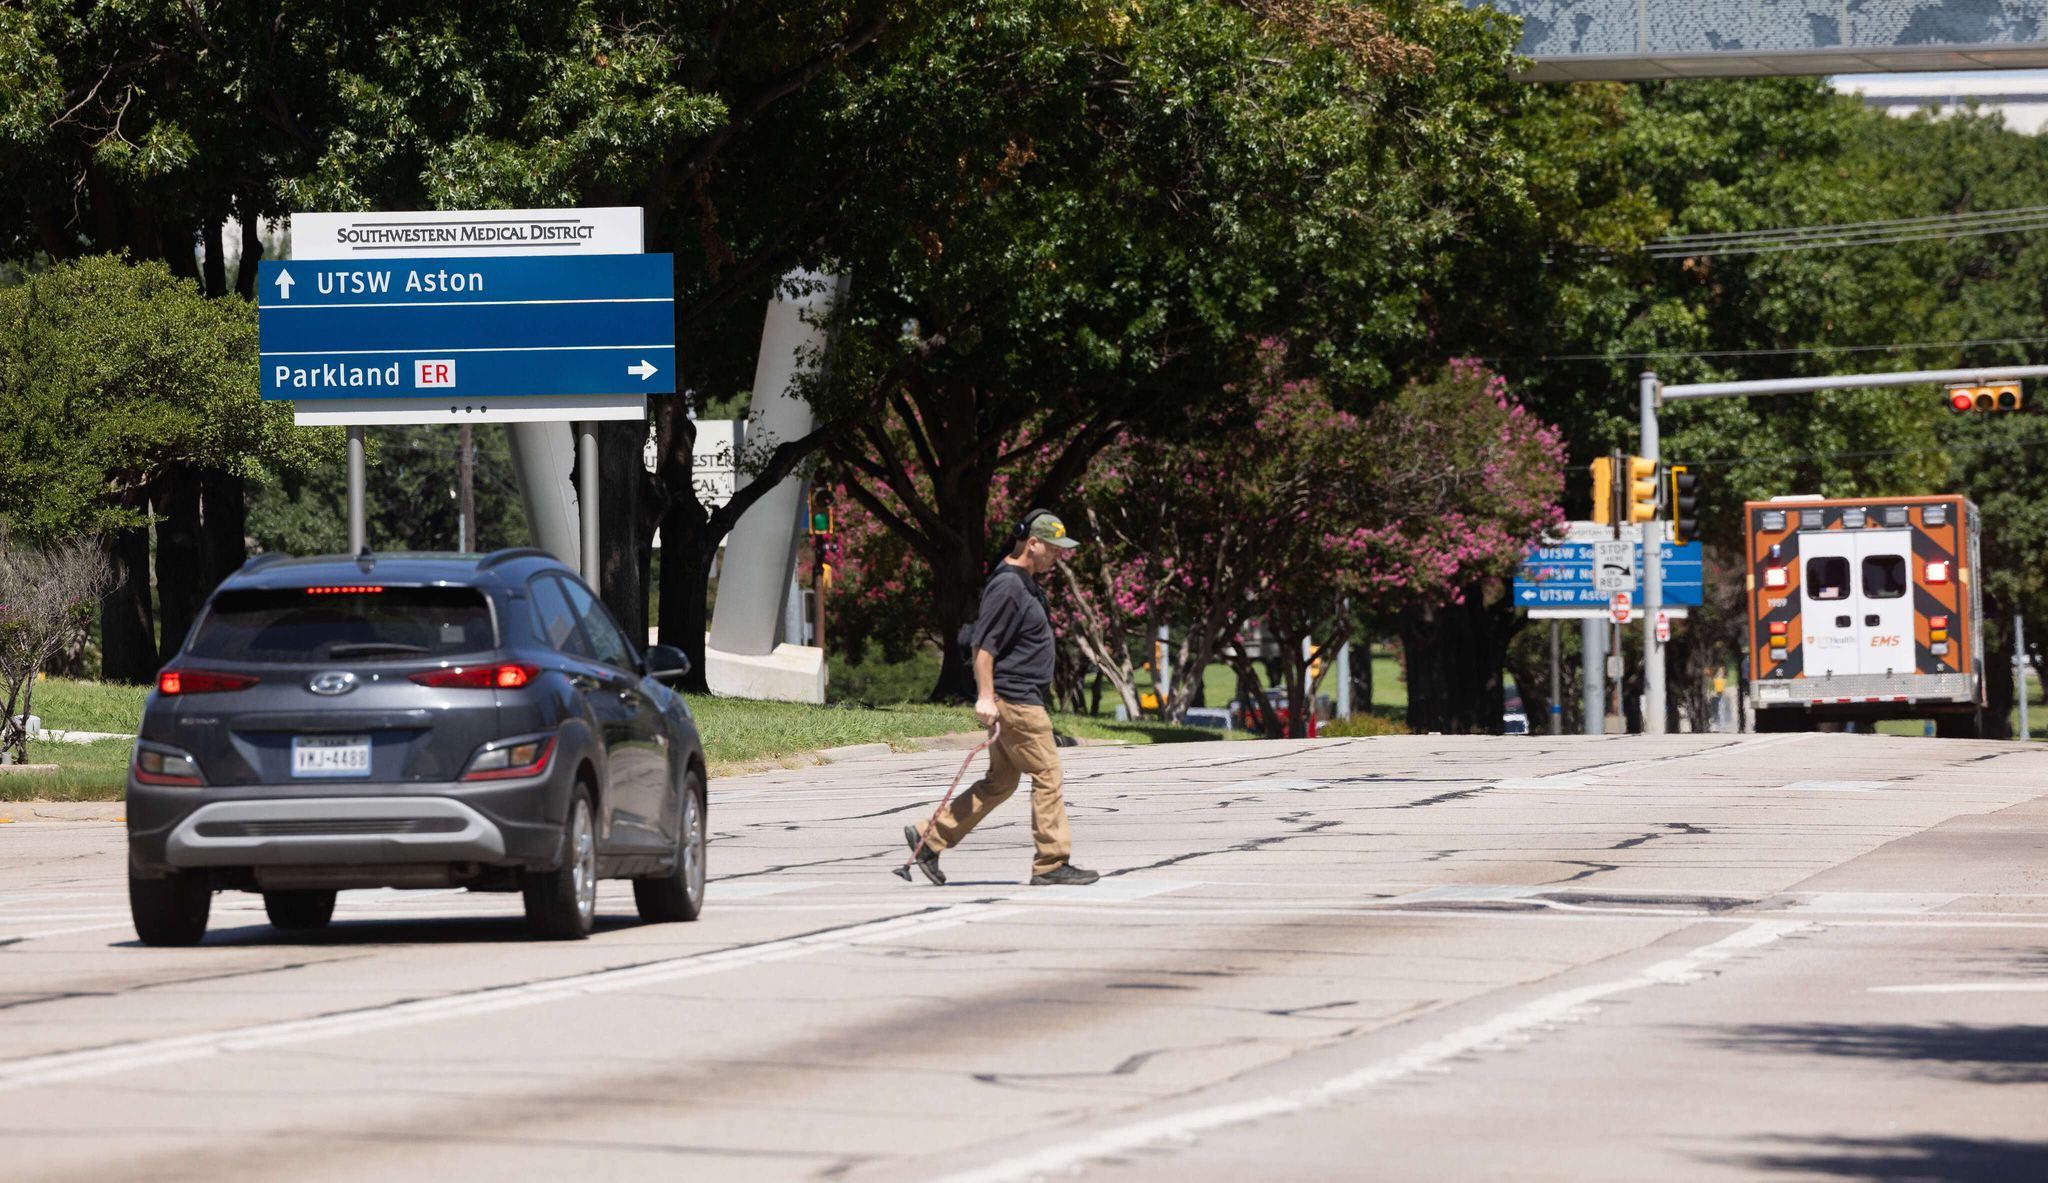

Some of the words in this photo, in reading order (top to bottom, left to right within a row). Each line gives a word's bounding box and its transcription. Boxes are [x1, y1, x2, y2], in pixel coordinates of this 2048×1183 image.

[337, 227, 457, 243] SOUTHWESTERN
[460, 226, 527, 242] MEDICAL
[530, 225, 594, 240] DISTRICT
[317, 271, 391, 294] UTSW
[405, 269, 484, 293] Aston
[275, 362, 399, 388] Parkland
[421, 364, 449, 384] ER
[1539, 547, 1575, 560] UTSW
[1599, 543, 1628, 555] STOP
[1599, 577, 1622, 588] RED
[1539, 589, 1575, 602] UTSW
[1871, 635, 1900, 648] EMS
